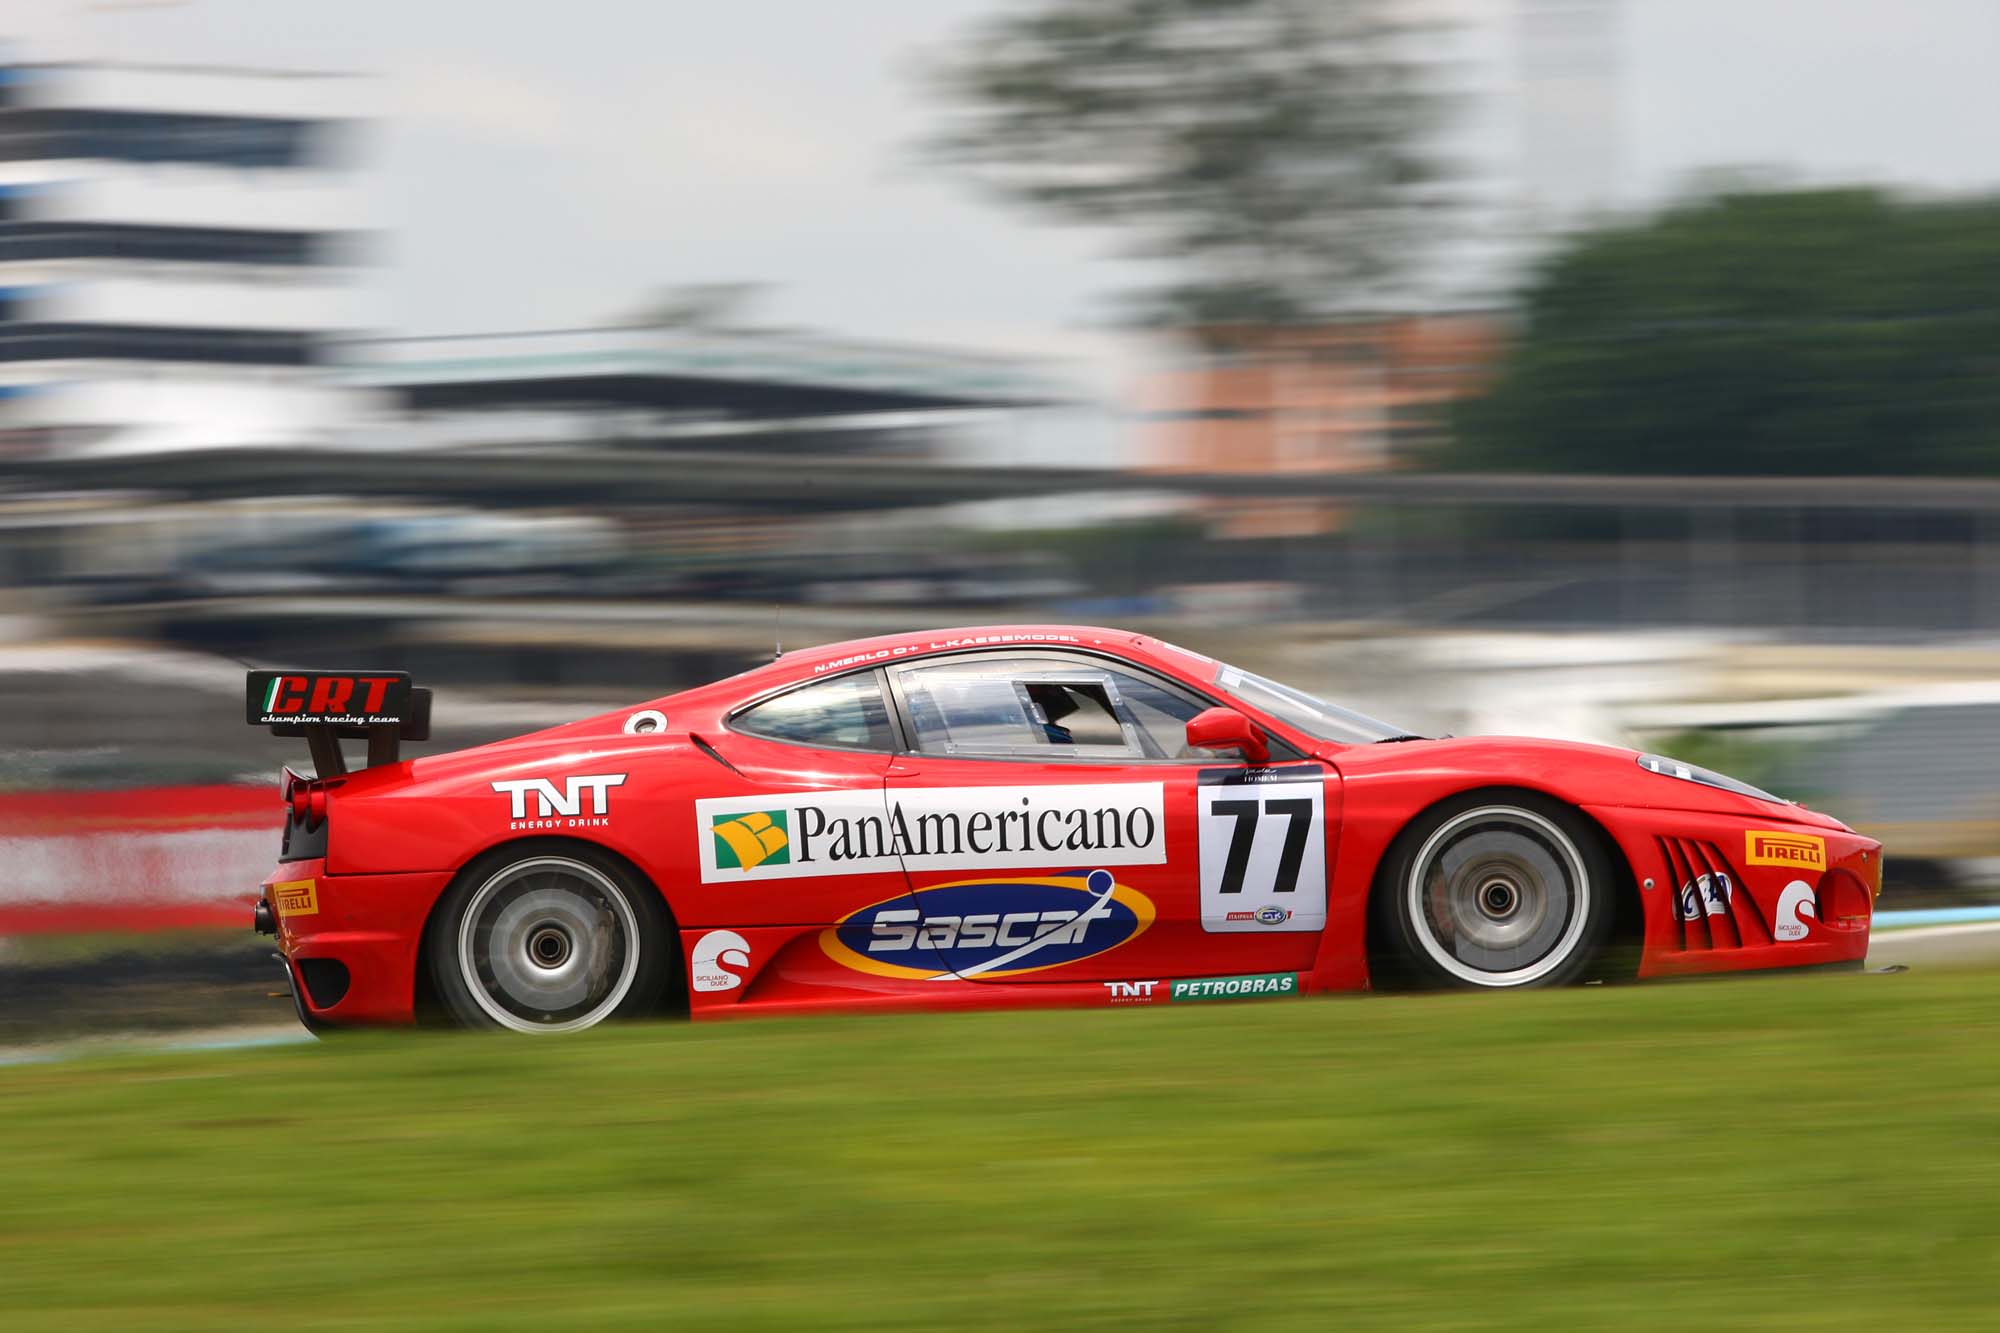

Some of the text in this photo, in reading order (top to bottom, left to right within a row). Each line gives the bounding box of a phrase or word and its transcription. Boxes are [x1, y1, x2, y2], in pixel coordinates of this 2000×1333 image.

[814, 650, 890, 673] N.MERLO
[270, 676, 399, 713] CRT
[260, 713, 400, 725] champion racing team
[490, 773, 628, 819] TNT
[510, 817, 609, 830] ENERGY DRINK
[794, 796, 1157, 863] PanAmericano
[1211, 798, 1313, 894] 77
[1755, 836, 1821, 864] PIRELLI
[1103, 980, 1159, 997] TNT
[1174, 977, 1292, 997] PETROBRAS
